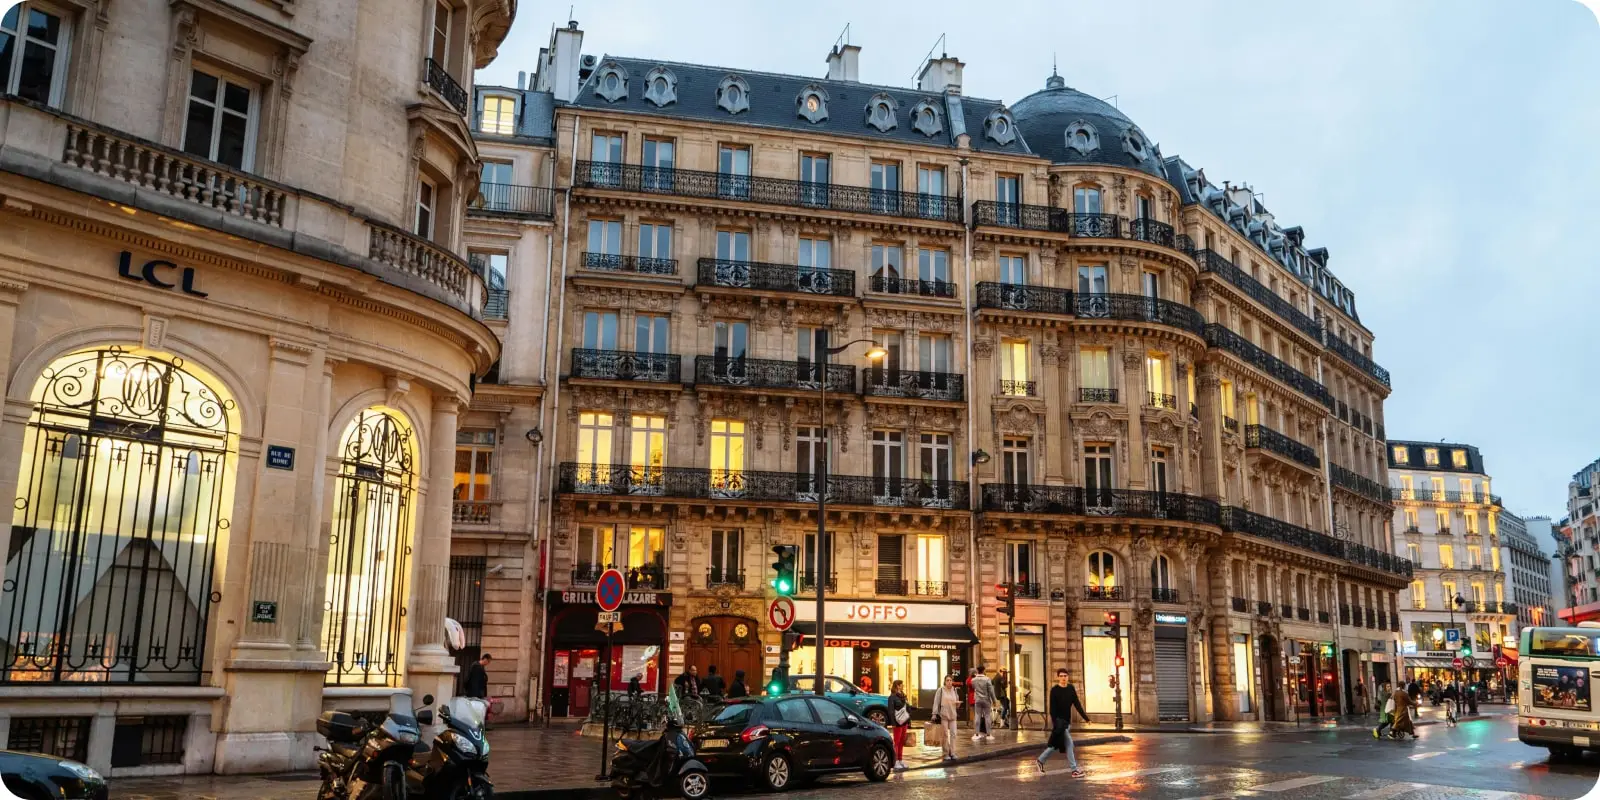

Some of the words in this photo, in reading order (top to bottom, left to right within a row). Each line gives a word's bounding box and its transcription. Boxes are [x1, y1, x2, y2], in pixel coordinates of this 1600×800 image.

[118, 250, 209, 298] LCL
[272, 457, 288, 465] ROME
[562, 592, 593, 604] GRILL
[622, 593, 656, 604] LAZARE
[848, 604, 908, 620] JOFFO
[1449, 631, 1456, 639] P
[1523, 705, 1531, 713] 70
